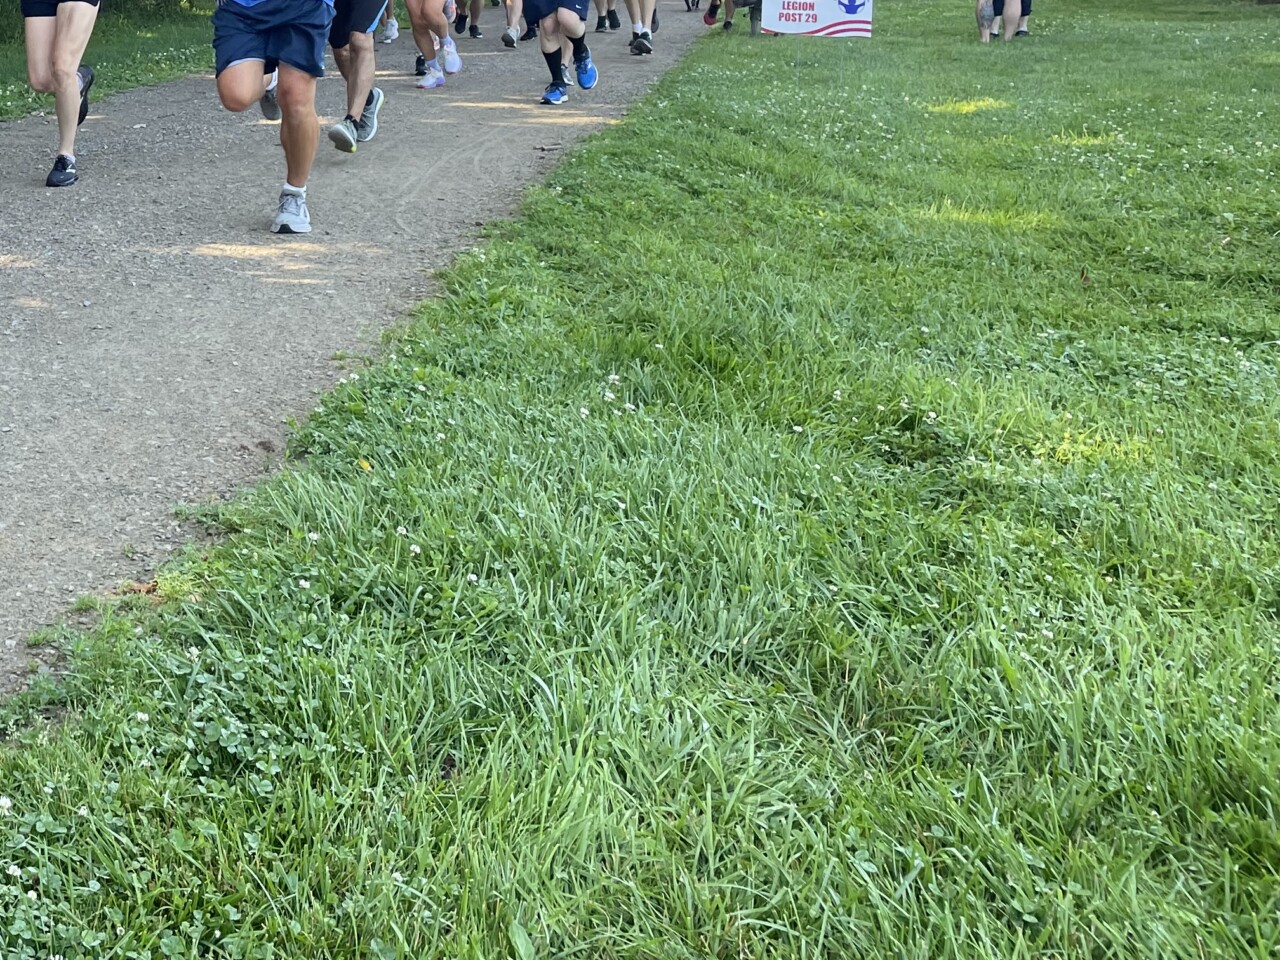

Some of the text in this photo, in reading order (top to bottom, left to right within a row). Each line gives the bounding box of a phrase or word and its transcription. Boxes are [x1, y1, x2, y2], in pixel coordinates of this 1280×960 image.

[782, 0, 816, 12] LEGION
[778, 12, 818, 24] POST 29
